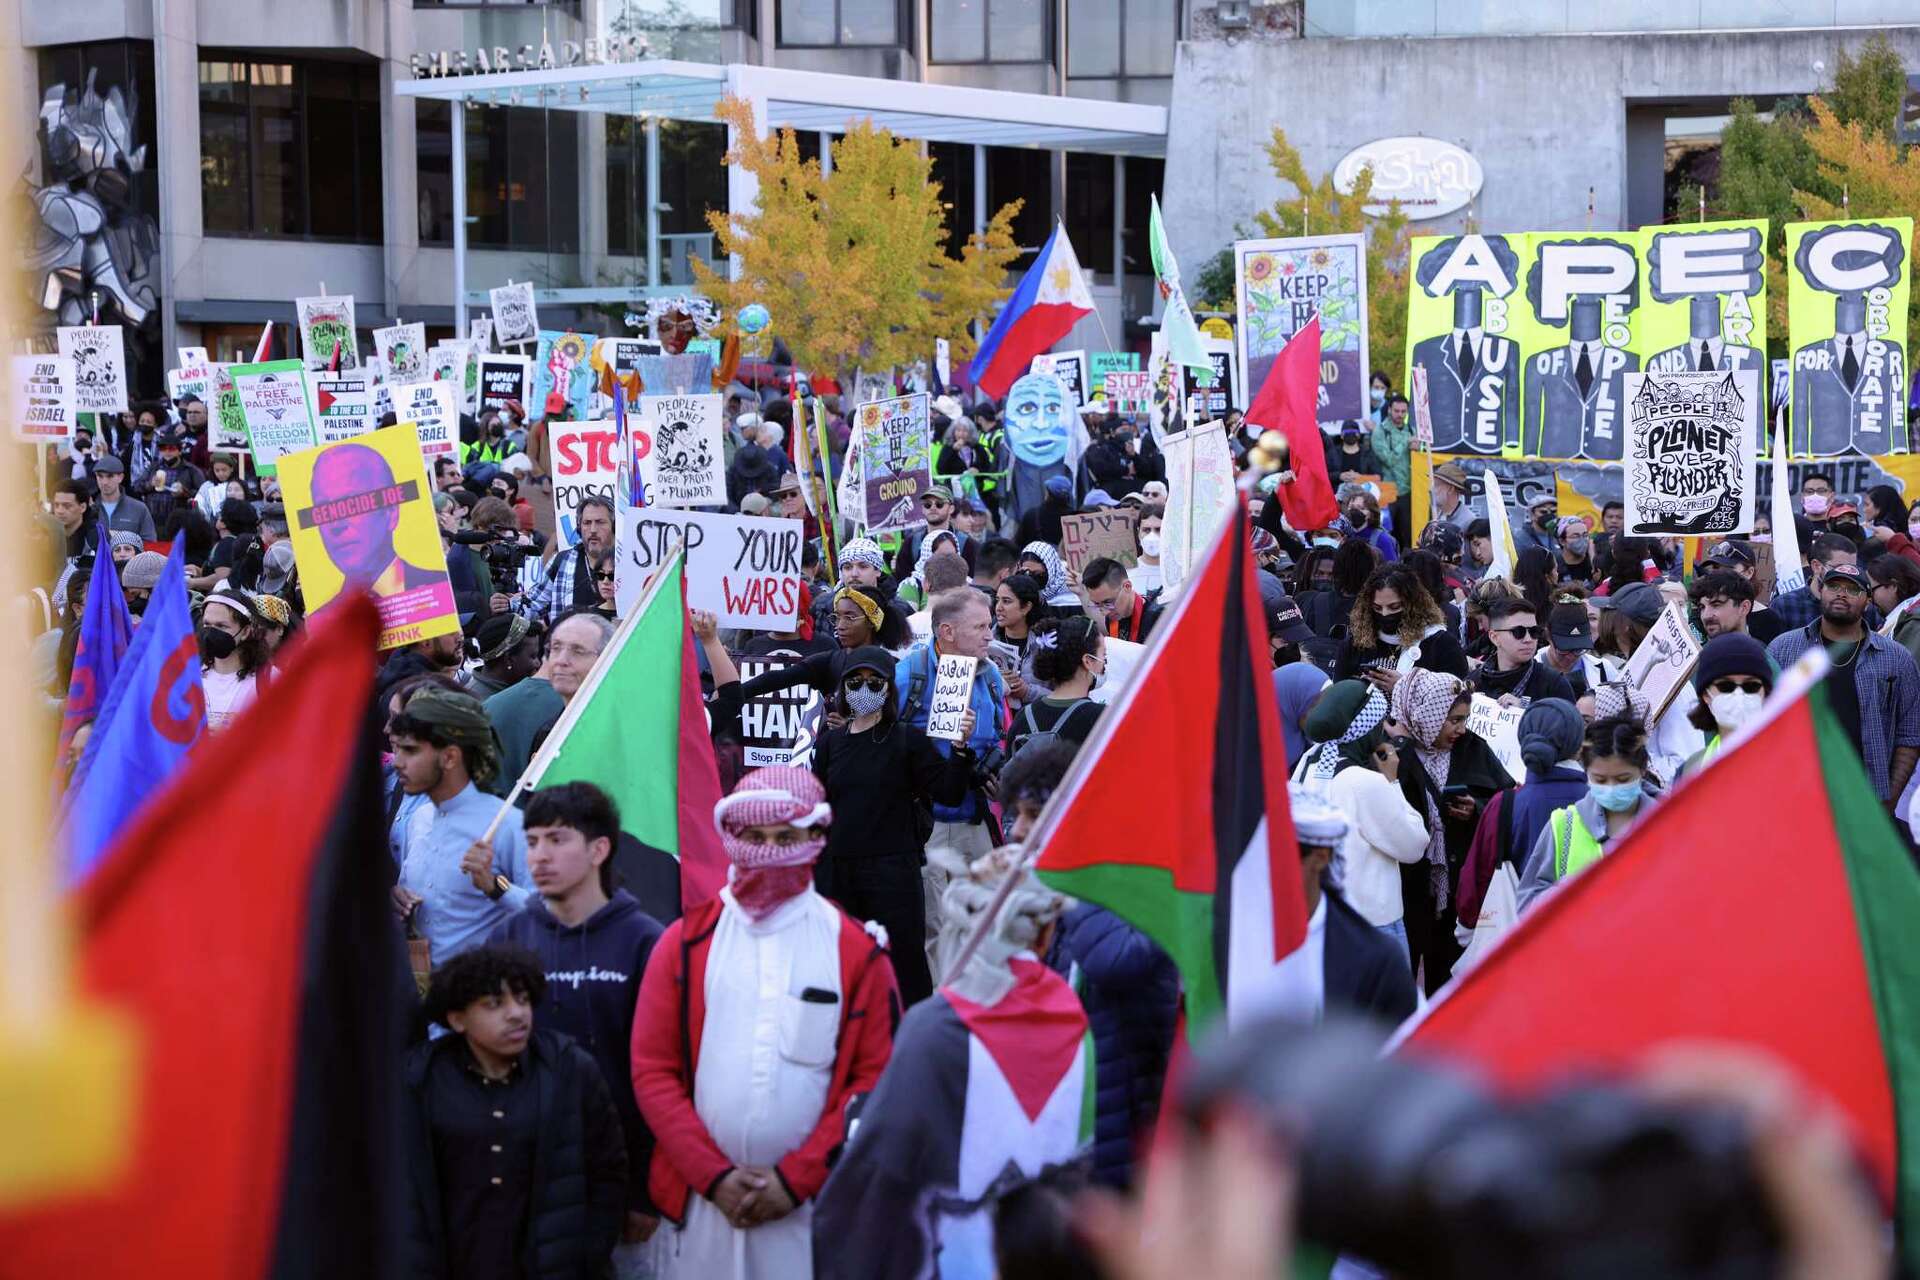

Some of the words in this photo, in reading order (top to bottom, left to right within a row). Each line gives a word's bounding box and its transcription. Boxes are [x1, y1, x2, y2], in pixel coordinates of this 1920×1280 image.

[1280, 275, 1329, 299] KEEP
[1295, 304, 1309, 317] IT
[71, 330, 104, 342] PEOPLE
[618, 344, 639, 352] 100%
[1536, 350, 1566, 376] OF
[1650, 350, 1687, 372] AND
[1795, 350, 1829, 370] FOR
[34, 363, 56, 376] END
[178, 367, 199, 381] LAND
[485, 371, 521, 382] WOMEN
[490, 382, 514, 393] OVER
[1106, 373, 1150, 388] STOP
[54, 385, 63, 394] TO
[256, 389, 289, 399] FREE
[377, 388, 388, 399] END
[414, 387, 432, 400] END
[245, 396, 304, 408] PALESTINE
[657, 399, 697, 415] PEOPLE
[26, 407, 65, 422] ISRAEL
[1650, 403, 1711, 418] PEOPLE
[324, 419, 364, 429] PALESTINE
[666, 411, 705, 425] PLANET
[882, 417, 910, 437] KEEP
[253, 429, 310, 440] FREEDOM
[1649, 419, 1733, 460] PLANET
[889, 458, 904, 471] THE
[1660, 453, 1716, 467] OVER
[657, 473, 682, 484] OVER
[683, 469, 714, 485] PROFIT
[1647, 460, 1731, 498] PLUNDER
[669, 485, 713, 500] PLUNDER
[879, 477, 917, 501] GROUND
[311, 492, 378, 525] GENOCIDE
[382, 487, 406, 507] JOE
[1722, 496, 1737, 508] NO
[1710, 510, 1735, 522] APEC
[1704, 521, 1734, 529] 2023
[632, 519, 704, 568] STOP
[733, 526, 800, 574] YOUR
[723, 576, 799, 616] WARS
[1472, 703, 1493, 718] CARE
[1498, 711, 1521, 726] NOT
[751, 752, 773, 764] Stop
